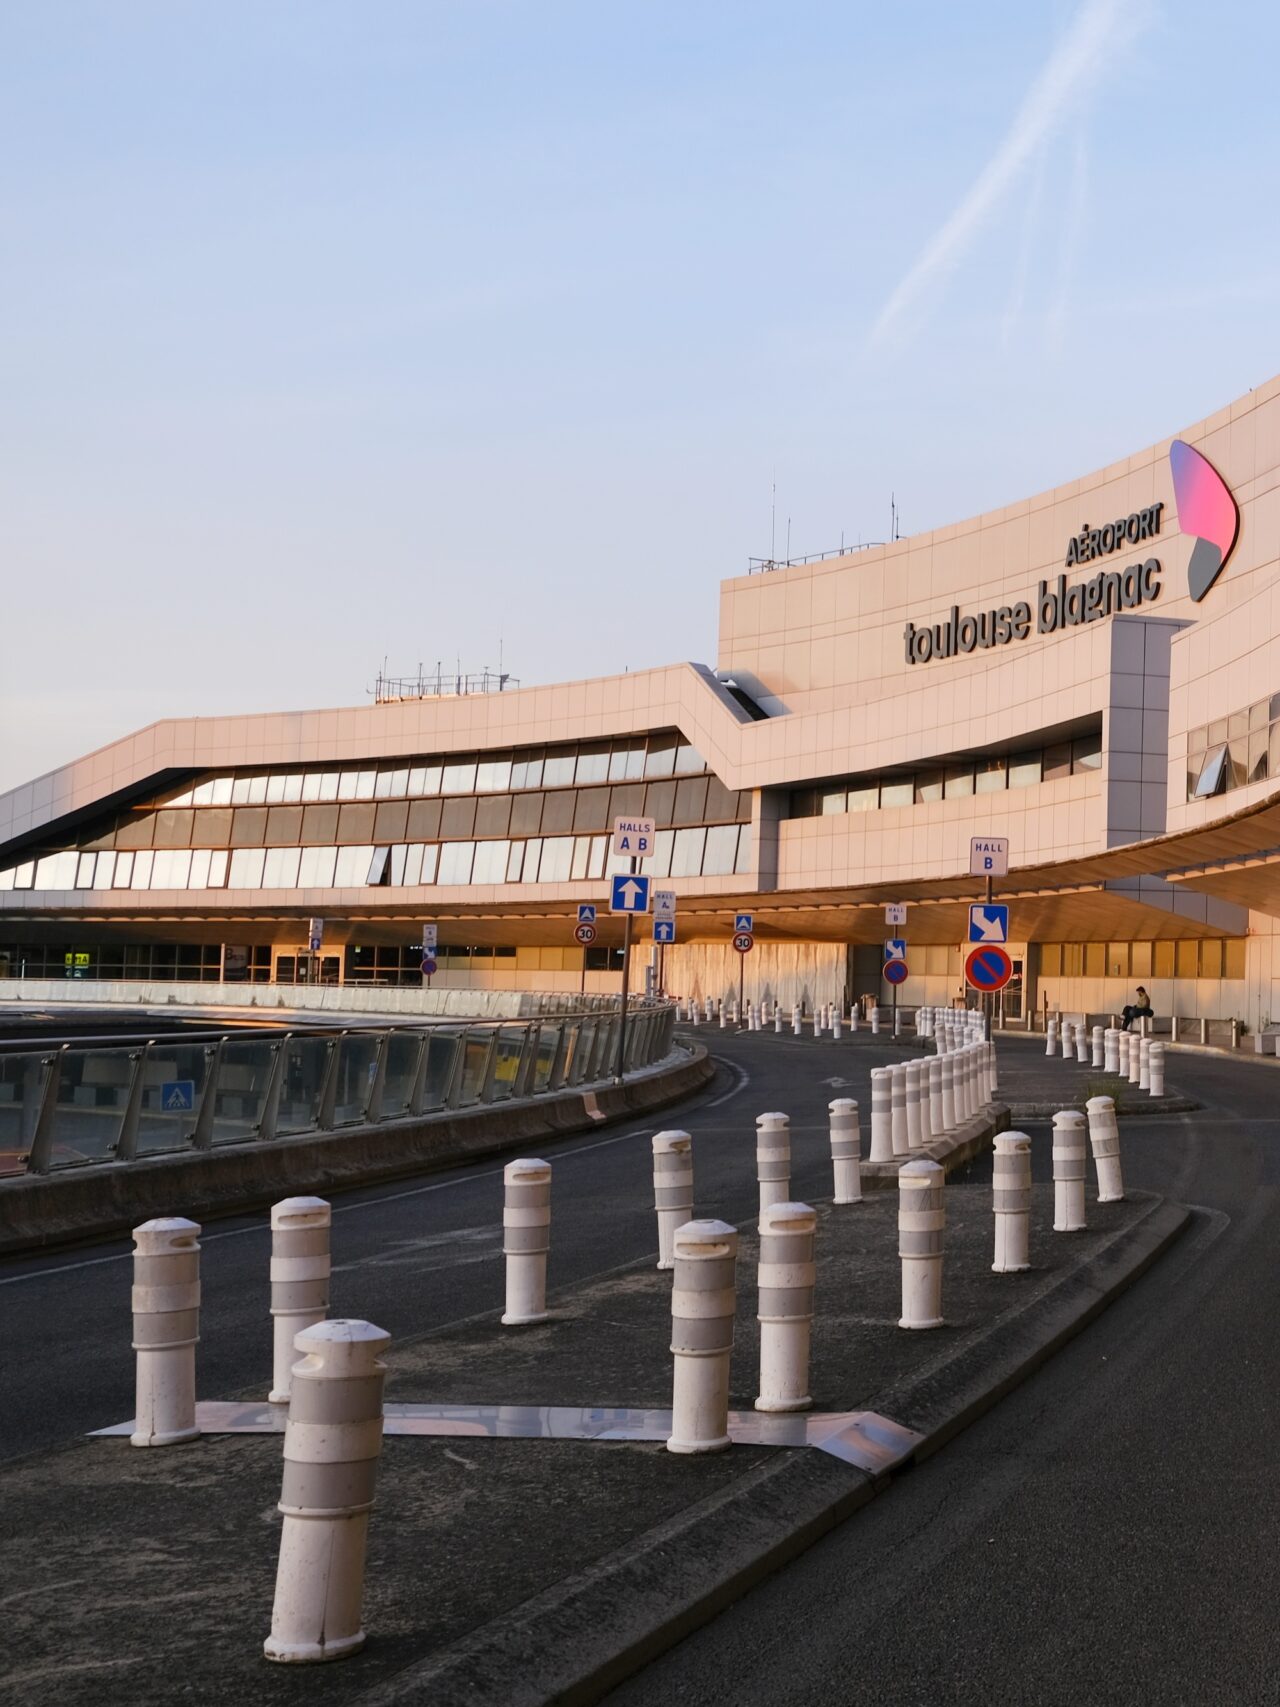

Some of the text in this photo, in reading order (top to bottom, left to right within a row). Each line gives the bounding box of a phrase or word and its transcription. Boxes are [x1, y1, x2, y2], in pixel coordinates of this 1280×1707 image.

[1065, 502, 1164, 567] AÉROPORT
[903, 557, 1162, 665] toulouse blagnac
[619, 822, 651, 833] HALLS
[620, 837, 648, 851] A B
[975, 843, 1003, 852] HALL
[984, 857, 993, 870] B
[893, 914, 899, 922] B
[578, 928, 593, 940] 30
[736, 937, 750, 948] 30
